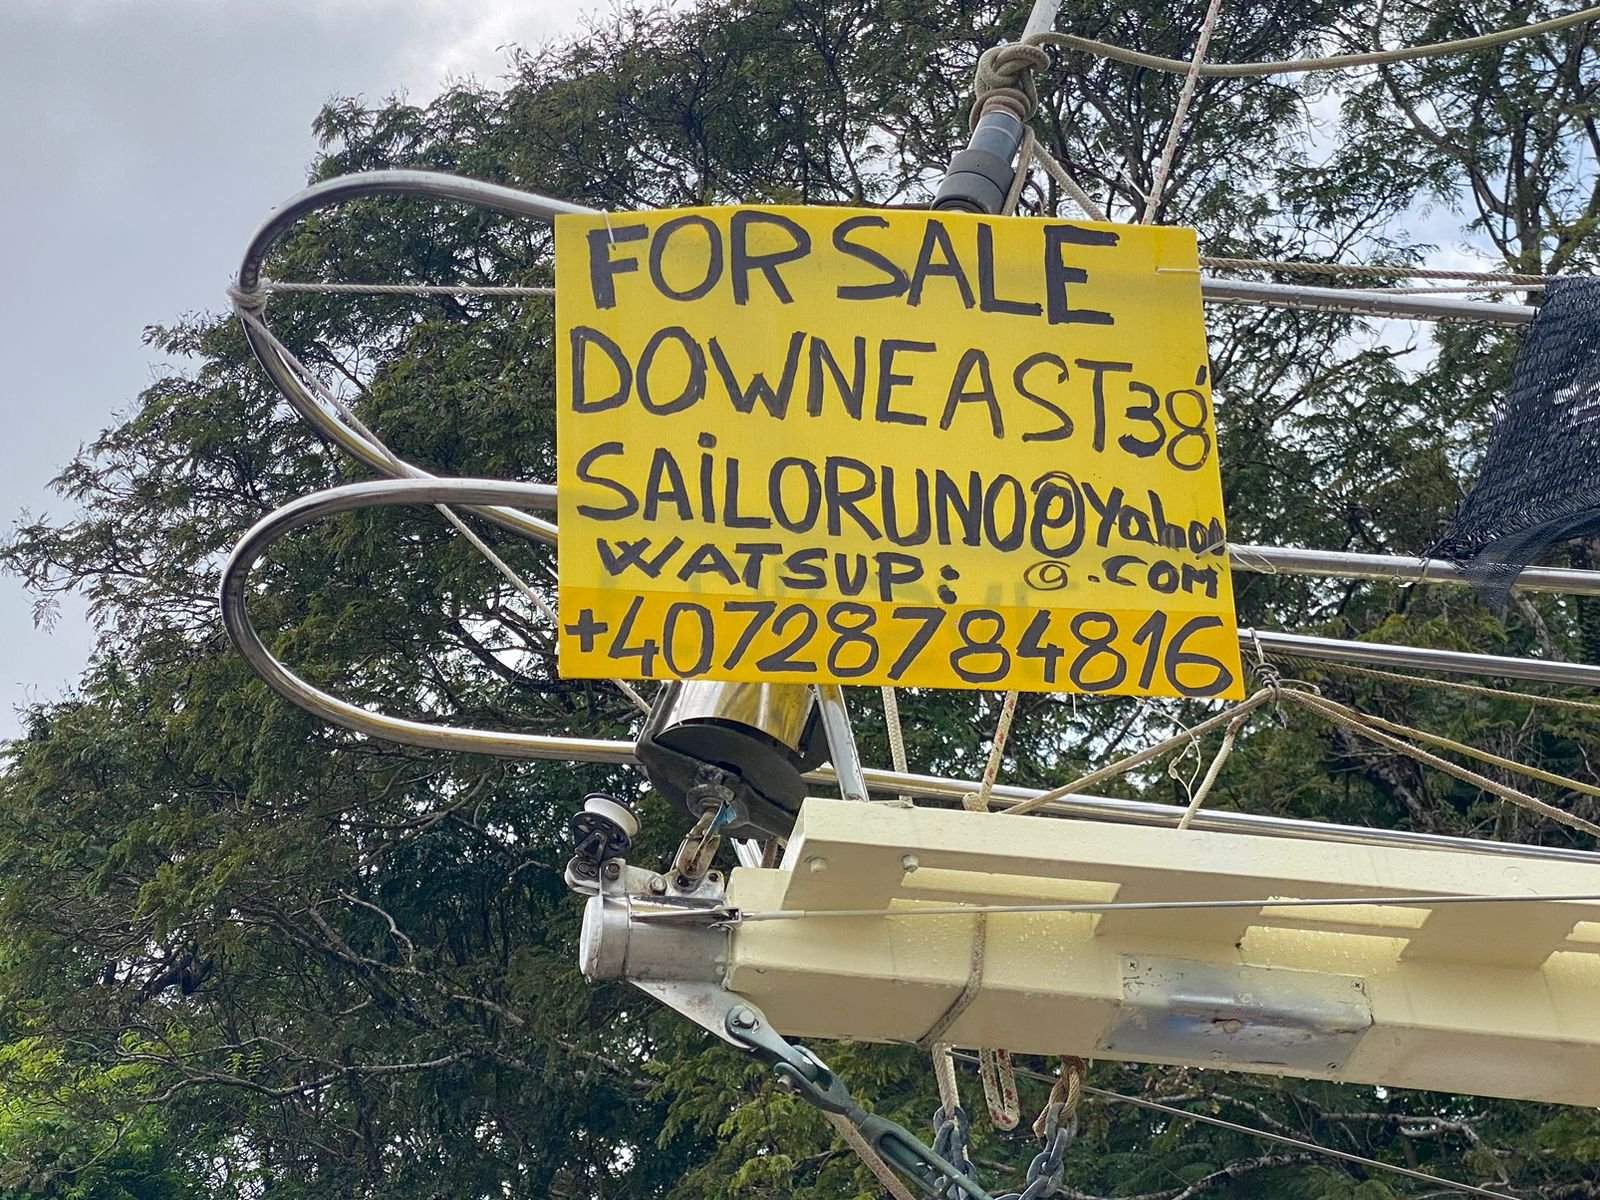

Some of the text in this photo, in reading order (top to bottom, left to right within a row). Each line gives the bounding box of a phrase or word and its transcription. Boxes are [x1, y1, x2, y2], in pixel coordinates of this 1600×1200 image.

[587, 210, 1120, 325] FOR SALE
[596, 536, 960, 604] WATSUP:
[564, 596, 1234, 697] +40728784816
